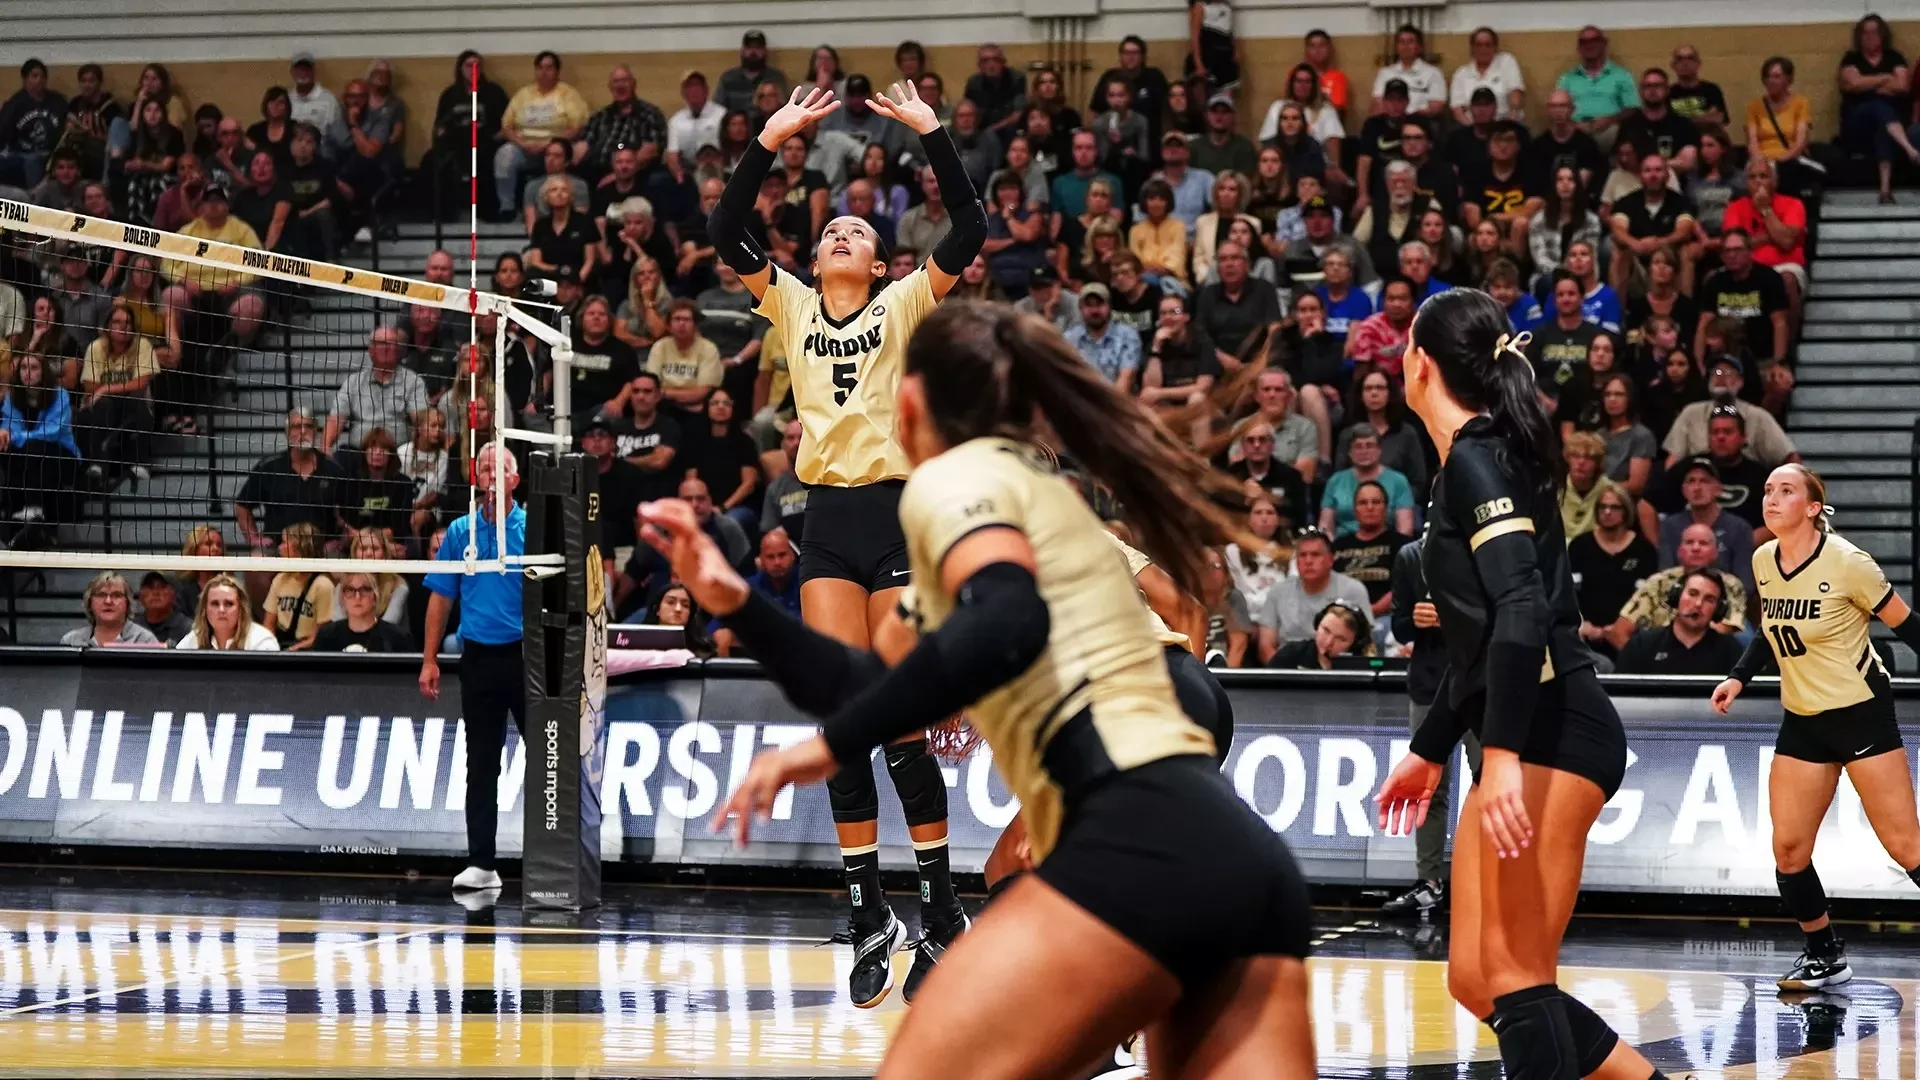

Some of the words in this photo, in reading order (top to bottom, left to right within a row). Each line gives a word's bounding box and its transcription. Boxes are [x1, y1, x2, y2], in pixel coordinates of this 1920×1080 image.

[1483, 189, 1524, 214] 72
[123, 226, 150, 246] BOILER
[150, 233, 161, 248] UP
[242, 250, 270, 269] PURDUE
[272, 256, 311, 278] VOLLEYBALL
[381, 278, 401, 294] BOILER
[400, 282, 409, 295] UP
[804, 323, 882, 357] PURDUE
[832, 362, 859, 407] 5
[276, 595, 314, 618] PURUE
[1762, 597, 1822, 619] PURDUE
[1769, 624, 1807, 658] 10
[544, 719, 560, 769] sports
[316, 714, 882, 821] UNIVRSIT
[543, 770, 558, 831] imports
[320, 845, 398, 855] DAKTRONICS
